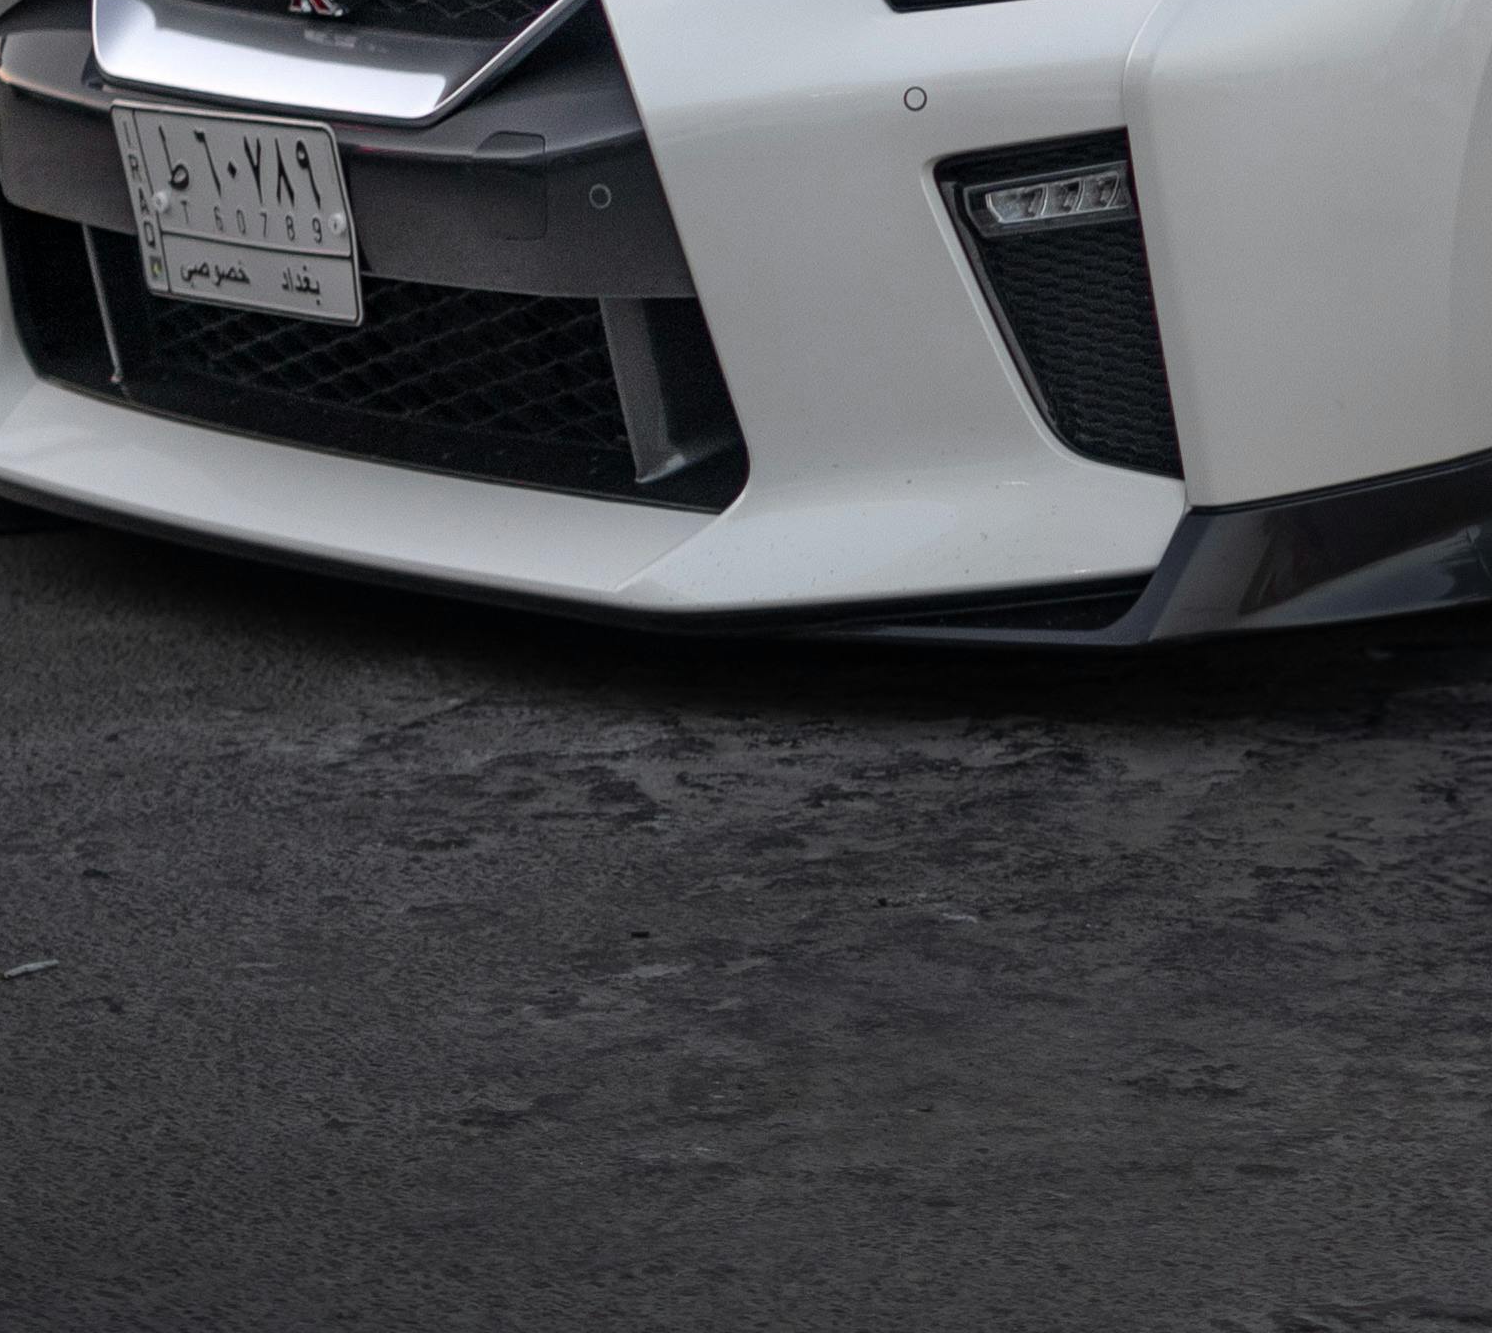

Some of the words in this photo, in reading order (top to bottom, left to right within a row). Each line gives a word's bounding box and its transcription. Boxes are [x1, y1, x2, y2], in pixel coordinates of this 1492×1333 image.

[123, 120, 157, 251] IRAQ
[213, 205, 324, 246] 60789
[180, 259, 251, 290] خصوصي
[281, 264, 322, 308] بغداد
